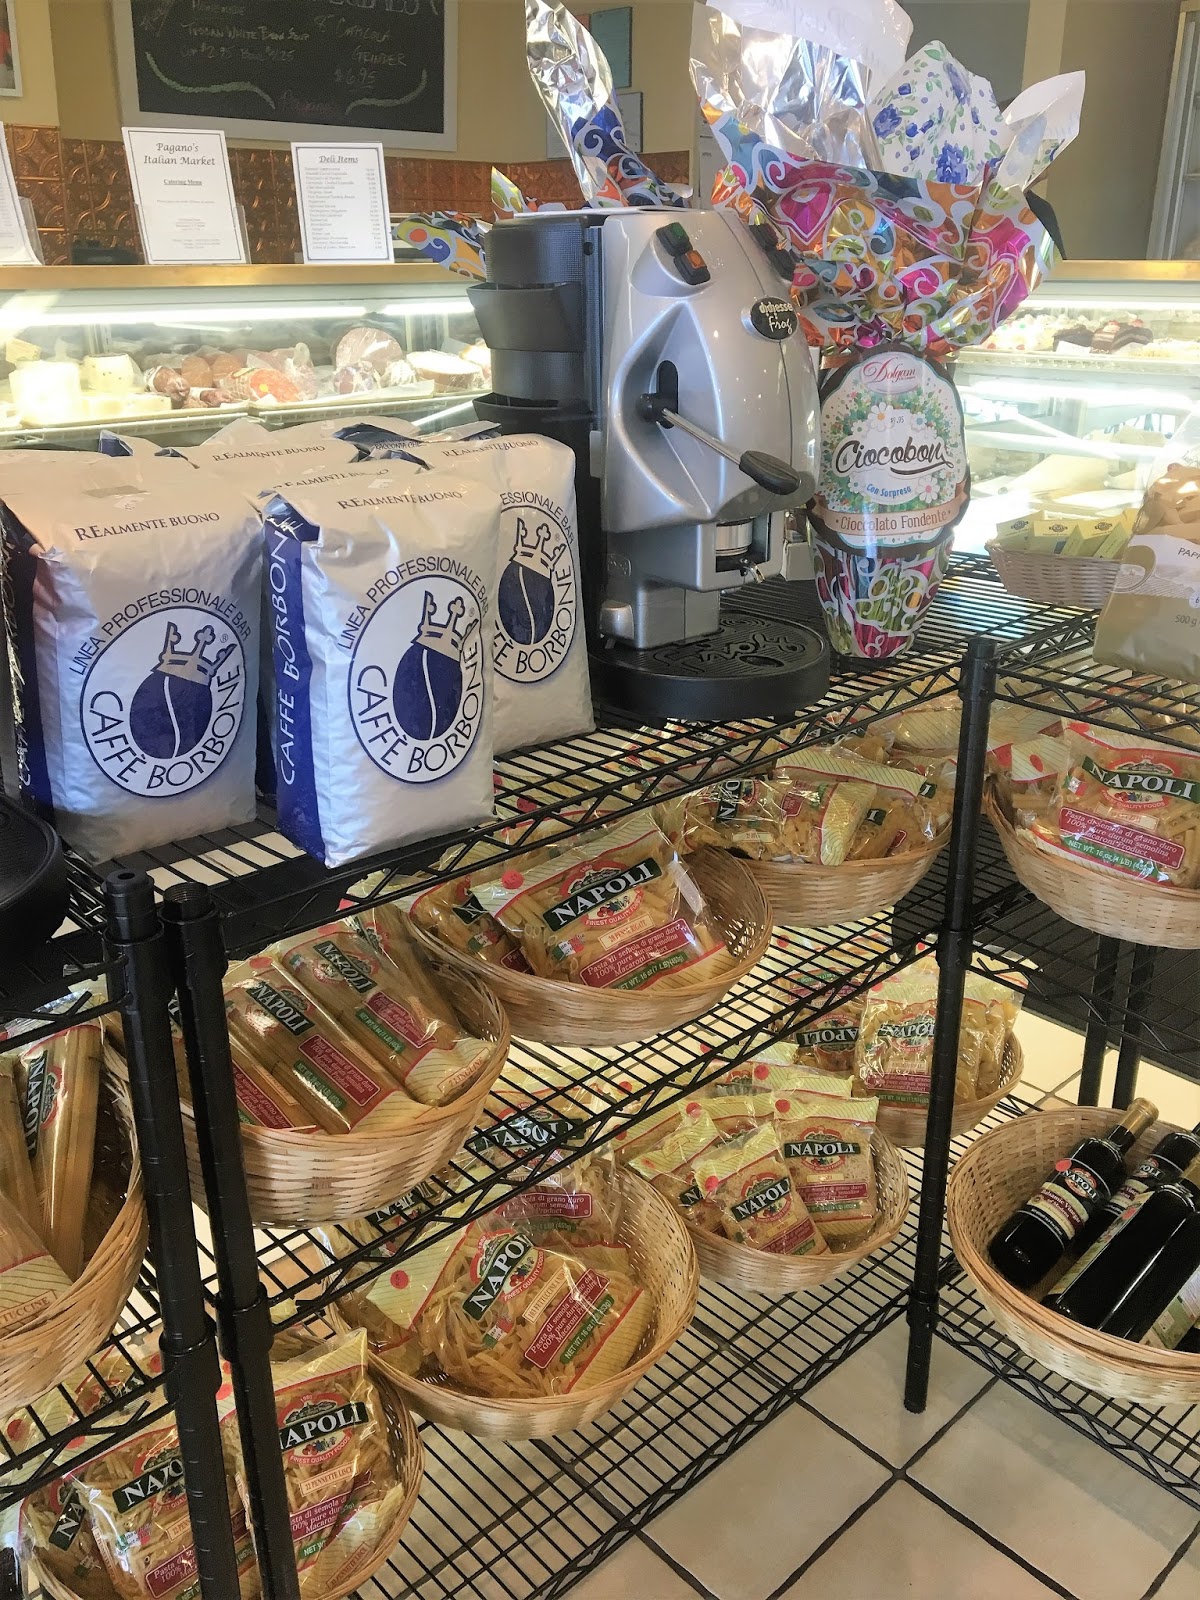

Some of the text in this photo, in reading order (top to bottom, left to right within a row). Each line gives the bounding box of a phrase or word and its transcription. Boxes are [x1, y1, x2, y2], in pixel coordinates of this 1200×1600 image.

[144, 155, 215, 166] Italian Market
[156, 142, 199, 154] Pagano's
[319, 155, 359, 164] Deli Items
[212, 445, 326, 462] REALMENTE BUONO
[503, 440, 539, 451] BUONO
[338, 490, 464, 510] REALMENTE BUONO
[866, 483, 912, 499] Con Sorpresa
[500, 491, 563, 520] ESSIONALE
[74, 511, 221, 541] REALMENTE BUONO
[840, 509, 949, 532] Cioccolato Fondente
[338, 605, 371, 650] LINEA
[366, 556, 481, 604] PROFESSIONALE
[69, 587, 252, 676] LINEA PROFESSIONALE BAR
[516, 565, 573, 674] BORBONE
[1174, 614, 1191, 624] 500
[357, 641, 479, 775] CAFFÈ BORBONE
[89, 664, 241, 790] CAFFÈ BORBONE
[277, 687, 296, 785] CAFFÈ
[1090, 763, 1196, 800] NAPOLI
[1143, 801, 1166, 809] FOODS
[1065, 810, 1086, 822] Pasta
[1125, 828, 1134, 838] di
[1159, 842, 1178, 854] duro
[1066, 817, 1170, 858] 100% durum semolina
[1068, 840, 1082, 850] NET
[1083, 845, 1095, 854] WT.
[1096, 848, 1104, 857] 16
[1118, 840, 1148, 857] Product
[552, 862, 654, 926] NAPOLI
[608, 911, 631, 924] QUALITY
[319, 942, 373, 990] NAPOLI
[587, 960, 608, 976] Pasta
[640, 938, 647, 947] di
[647, 931, 665, 945] grano
[596, 964, 616, 980] 100%
[616, 954, 633, 970] pure
[654, 933, 679, 951] semolina
[614, 955, 646, 978] Macaroni
[628, 976, 641, 987] WT.
[640, 972, 647, 981] 16
[251, 984, 309, 1032] NAPOLI
[804, 1027, 859, 1046] APOLI
[790, 1143, 855, 1156] NAPOLI
[1063, 1169, 1097, 1199] NAPOLI
[504, 1286, 522, 1301] FINEST
[522, 1270, 539, 1290] QUALITY
[3, 1296, 51, 1322] TUCCINE
[531, 1302, 571, 1354] Pasta di semola
[539, 1319, 567, 1354] 100% pure
[555, 1313, 579, 1344] Macaroni
[564, 1345, 577, 1360] NET
[573, 1336, 584, 1348] WT.
[580, 1328, 589, 1337] 16
[289, 1436, 352, 1464] FINEST QUALITY FOODS
[310, 1472, 339, 1488] PENNETTE
[292, 1519, 309, 1532] 00%
[310, 1513, 327, 1528] pure
[328, 1506, 341, 1516] dur
[304, 1510, 312, 1519] di
[314, 1499, 339, 1514] semola
[303, 1544, 317, 1557] NET
[153, 1555, 185, 1580] Pasta di
[161, 1566, 182, 1584] 100%
